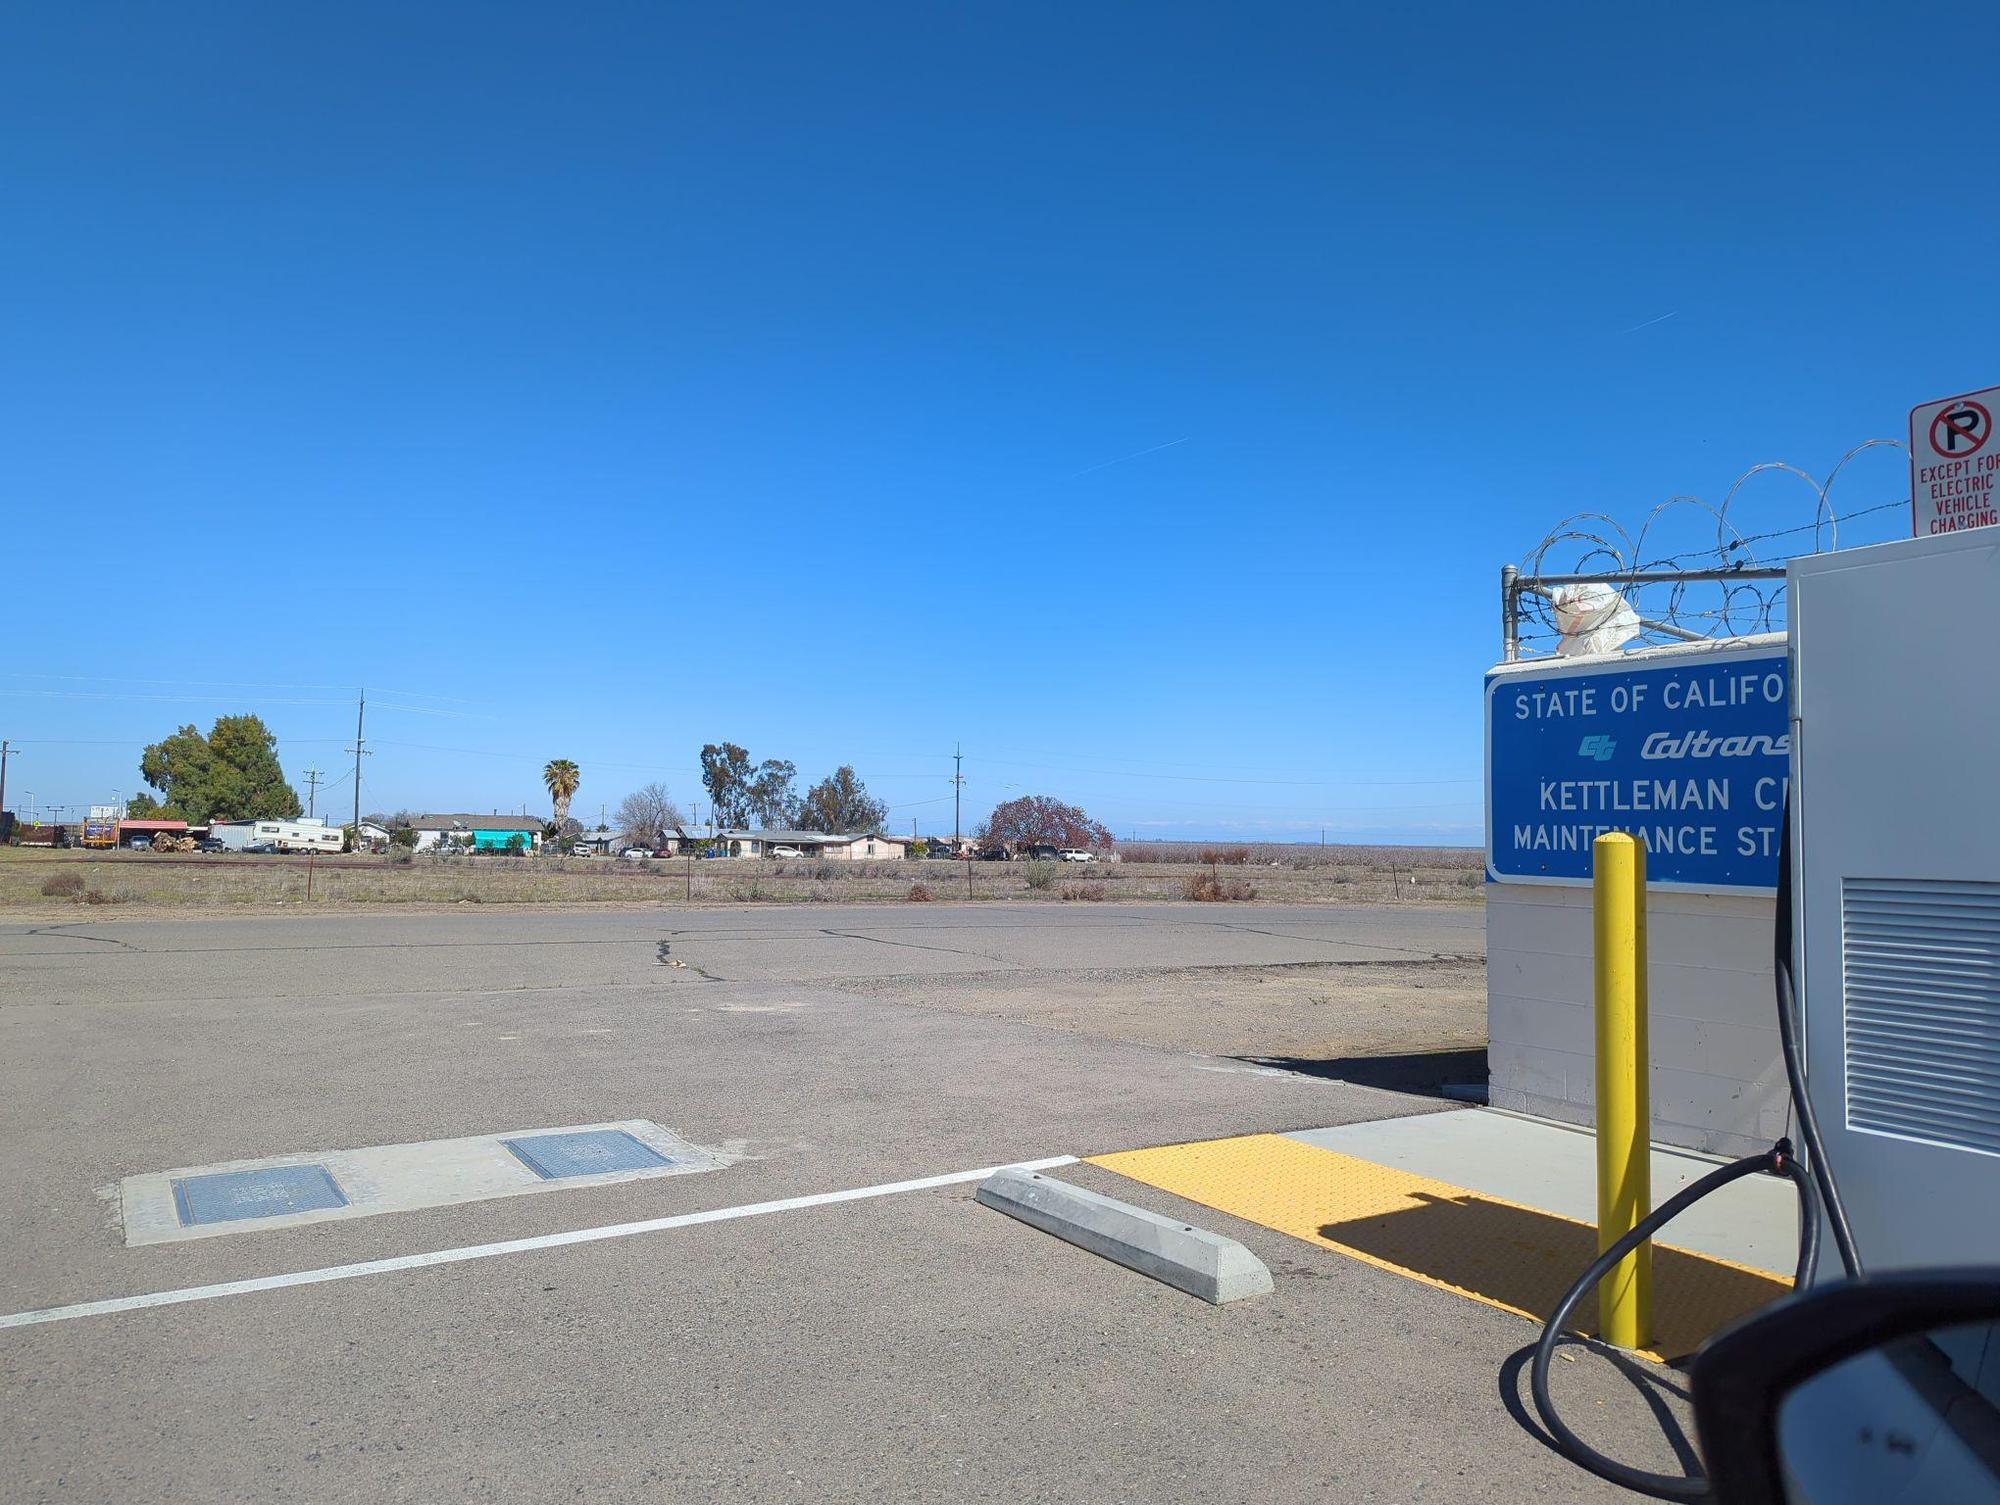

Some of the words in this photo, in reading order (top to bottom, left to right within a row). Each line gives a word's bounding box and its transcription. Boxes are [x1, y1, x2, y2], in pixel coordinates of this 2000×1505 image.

[1920, 459, 1970, 484] EXCEPT
[1931, 473, 1994, 499] ELECTRIC
[1936, 492, 1991, 516] VEHICLE
[1930, 509, 1998, 535] CHARGING
[1515, 689, 1597, 720] STATE
[1611, 684, 1648, 713] OF
[1663, 673, 1784, 710] CALIFO
[1540, 778, 1729, 811] KETTLEMAN
[1513, 824, 1718, 856] MAINTANCE
[1737, 827, 1781, 857] ST
